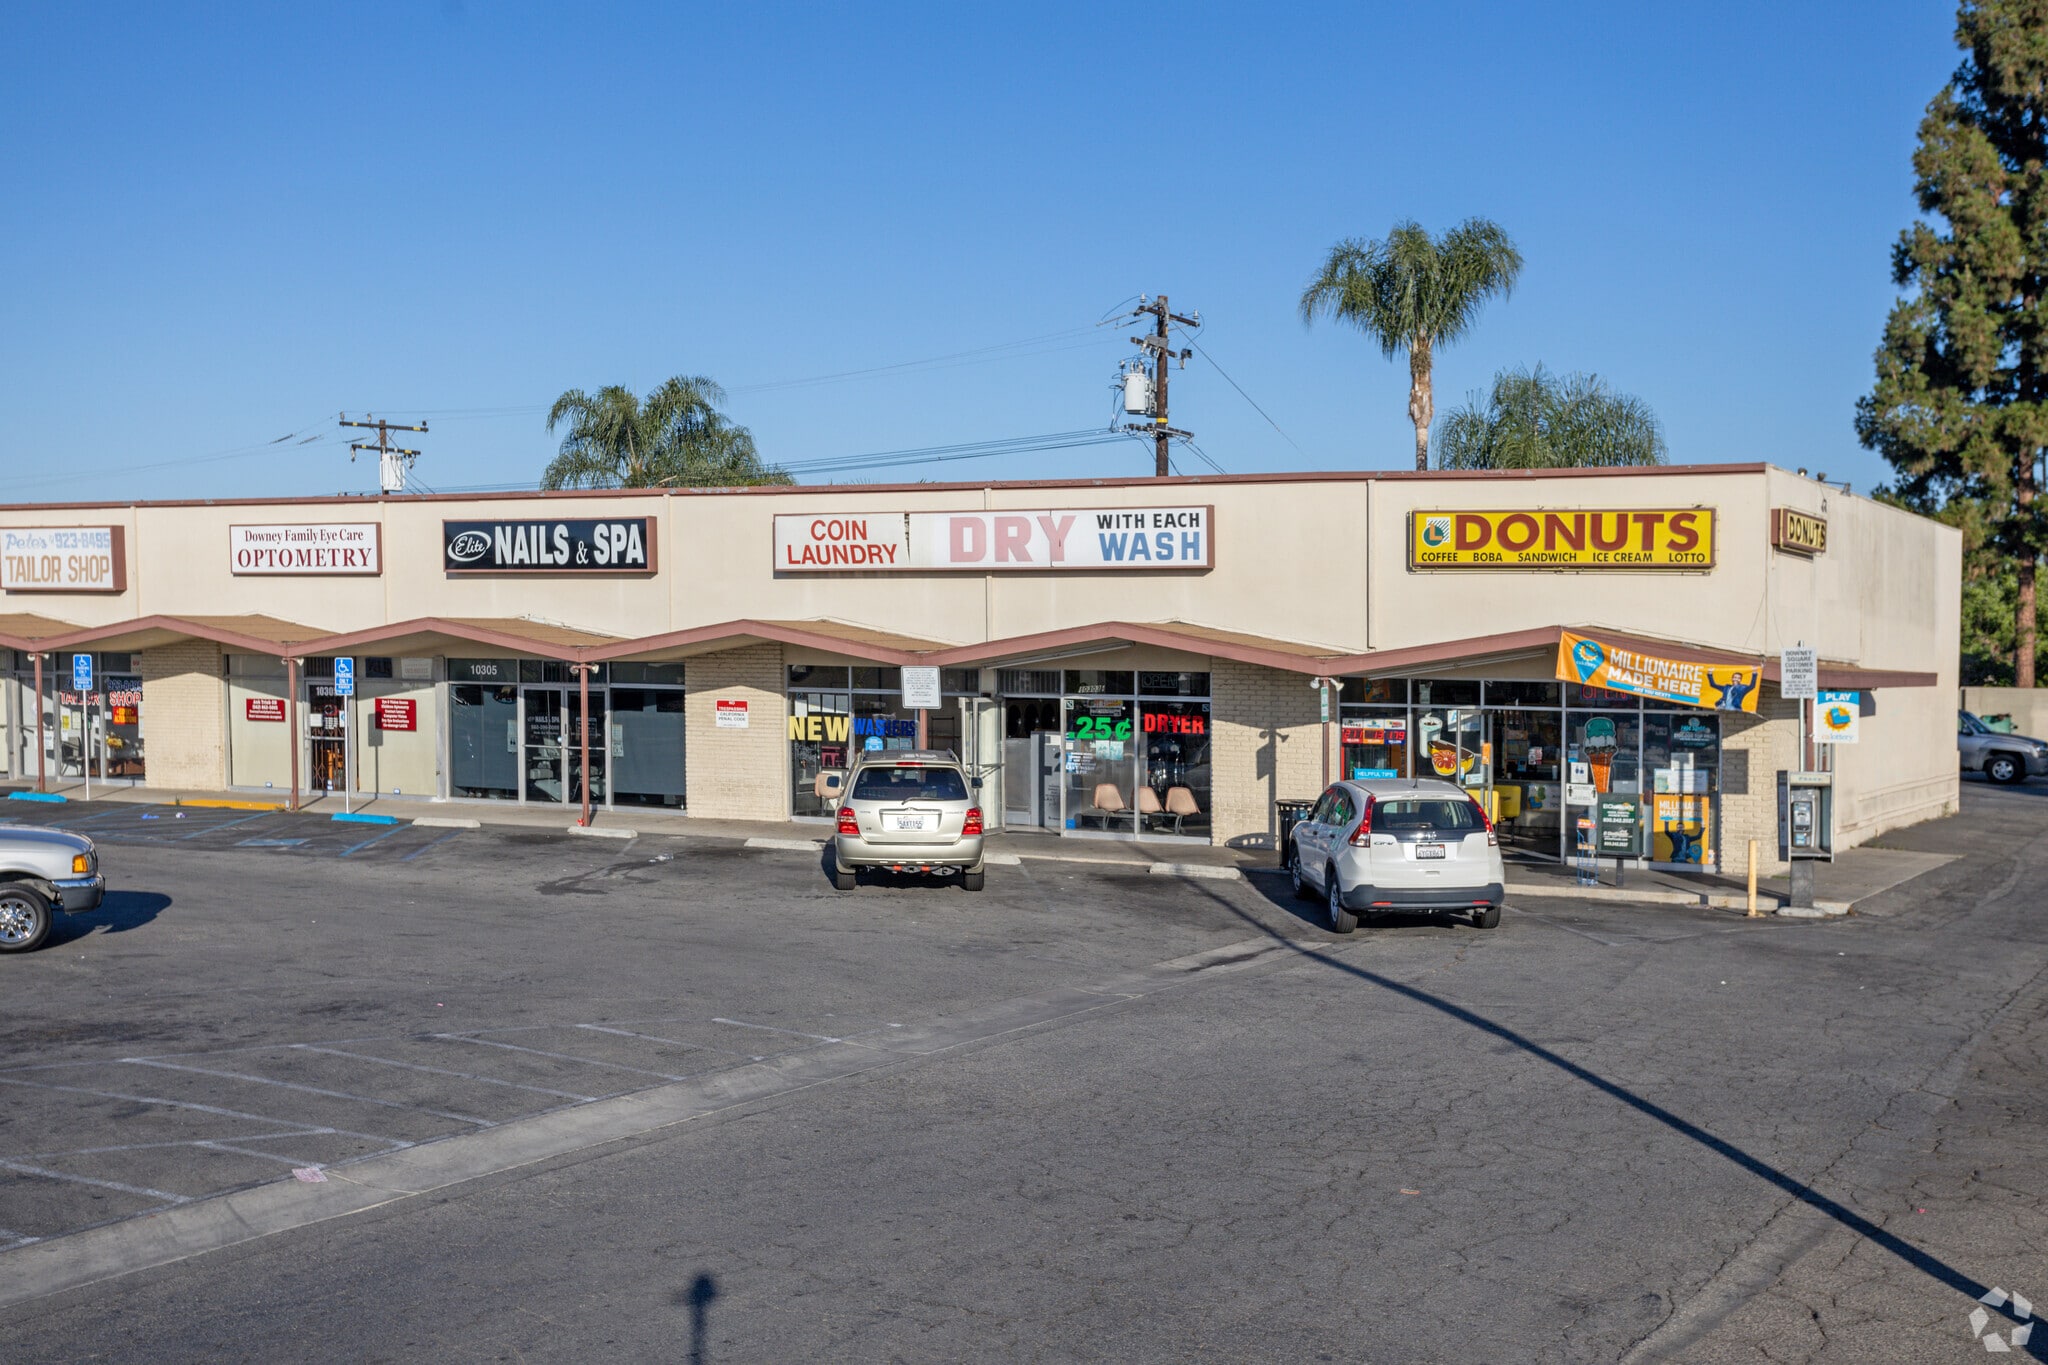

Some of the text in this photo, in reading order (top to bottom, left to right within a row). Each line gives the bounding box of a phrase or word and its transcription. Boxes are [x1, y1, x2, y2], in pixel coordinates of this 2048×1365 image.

[810, 520, 868, 541] COIN
[1096, 512, 1200, 529] WITH EACH
[245, 528, 364, 544] Downey Family Eye Care
[950, 515, 1077, 563] DRY
[1456, 512, 1699, 552] DONUTS
[1790, 516, 1825, 548] DONUTS
[455, 523, 644, 565] Elite NAILS & SPA
[787, 544, 898, 565] LAUNDRY
[1098, 532, 1200, 561] WASH
[238, 548, 372, 568] OPTOMETRY
[1422, 552, 1705, 562] COFFEE BOBA SANDWICH ICE CREAM LOTTO
[5, 554, 110, 583] TAILOR SHOP
[470, 664, 498, 676] 10305
[1610, 648, 1703, 683] MILLIONAIRE
[316, 686, 337, 696] 1030
[1608, 666, 1702, 696] MADE HERE
[110, 691, 142, 706] SHOP
[1826, 693, 1852, 701] PLAY
[788, 716, 916, 742] NEW WASHERS
[1144, 713, 1204, 734] DRYER
